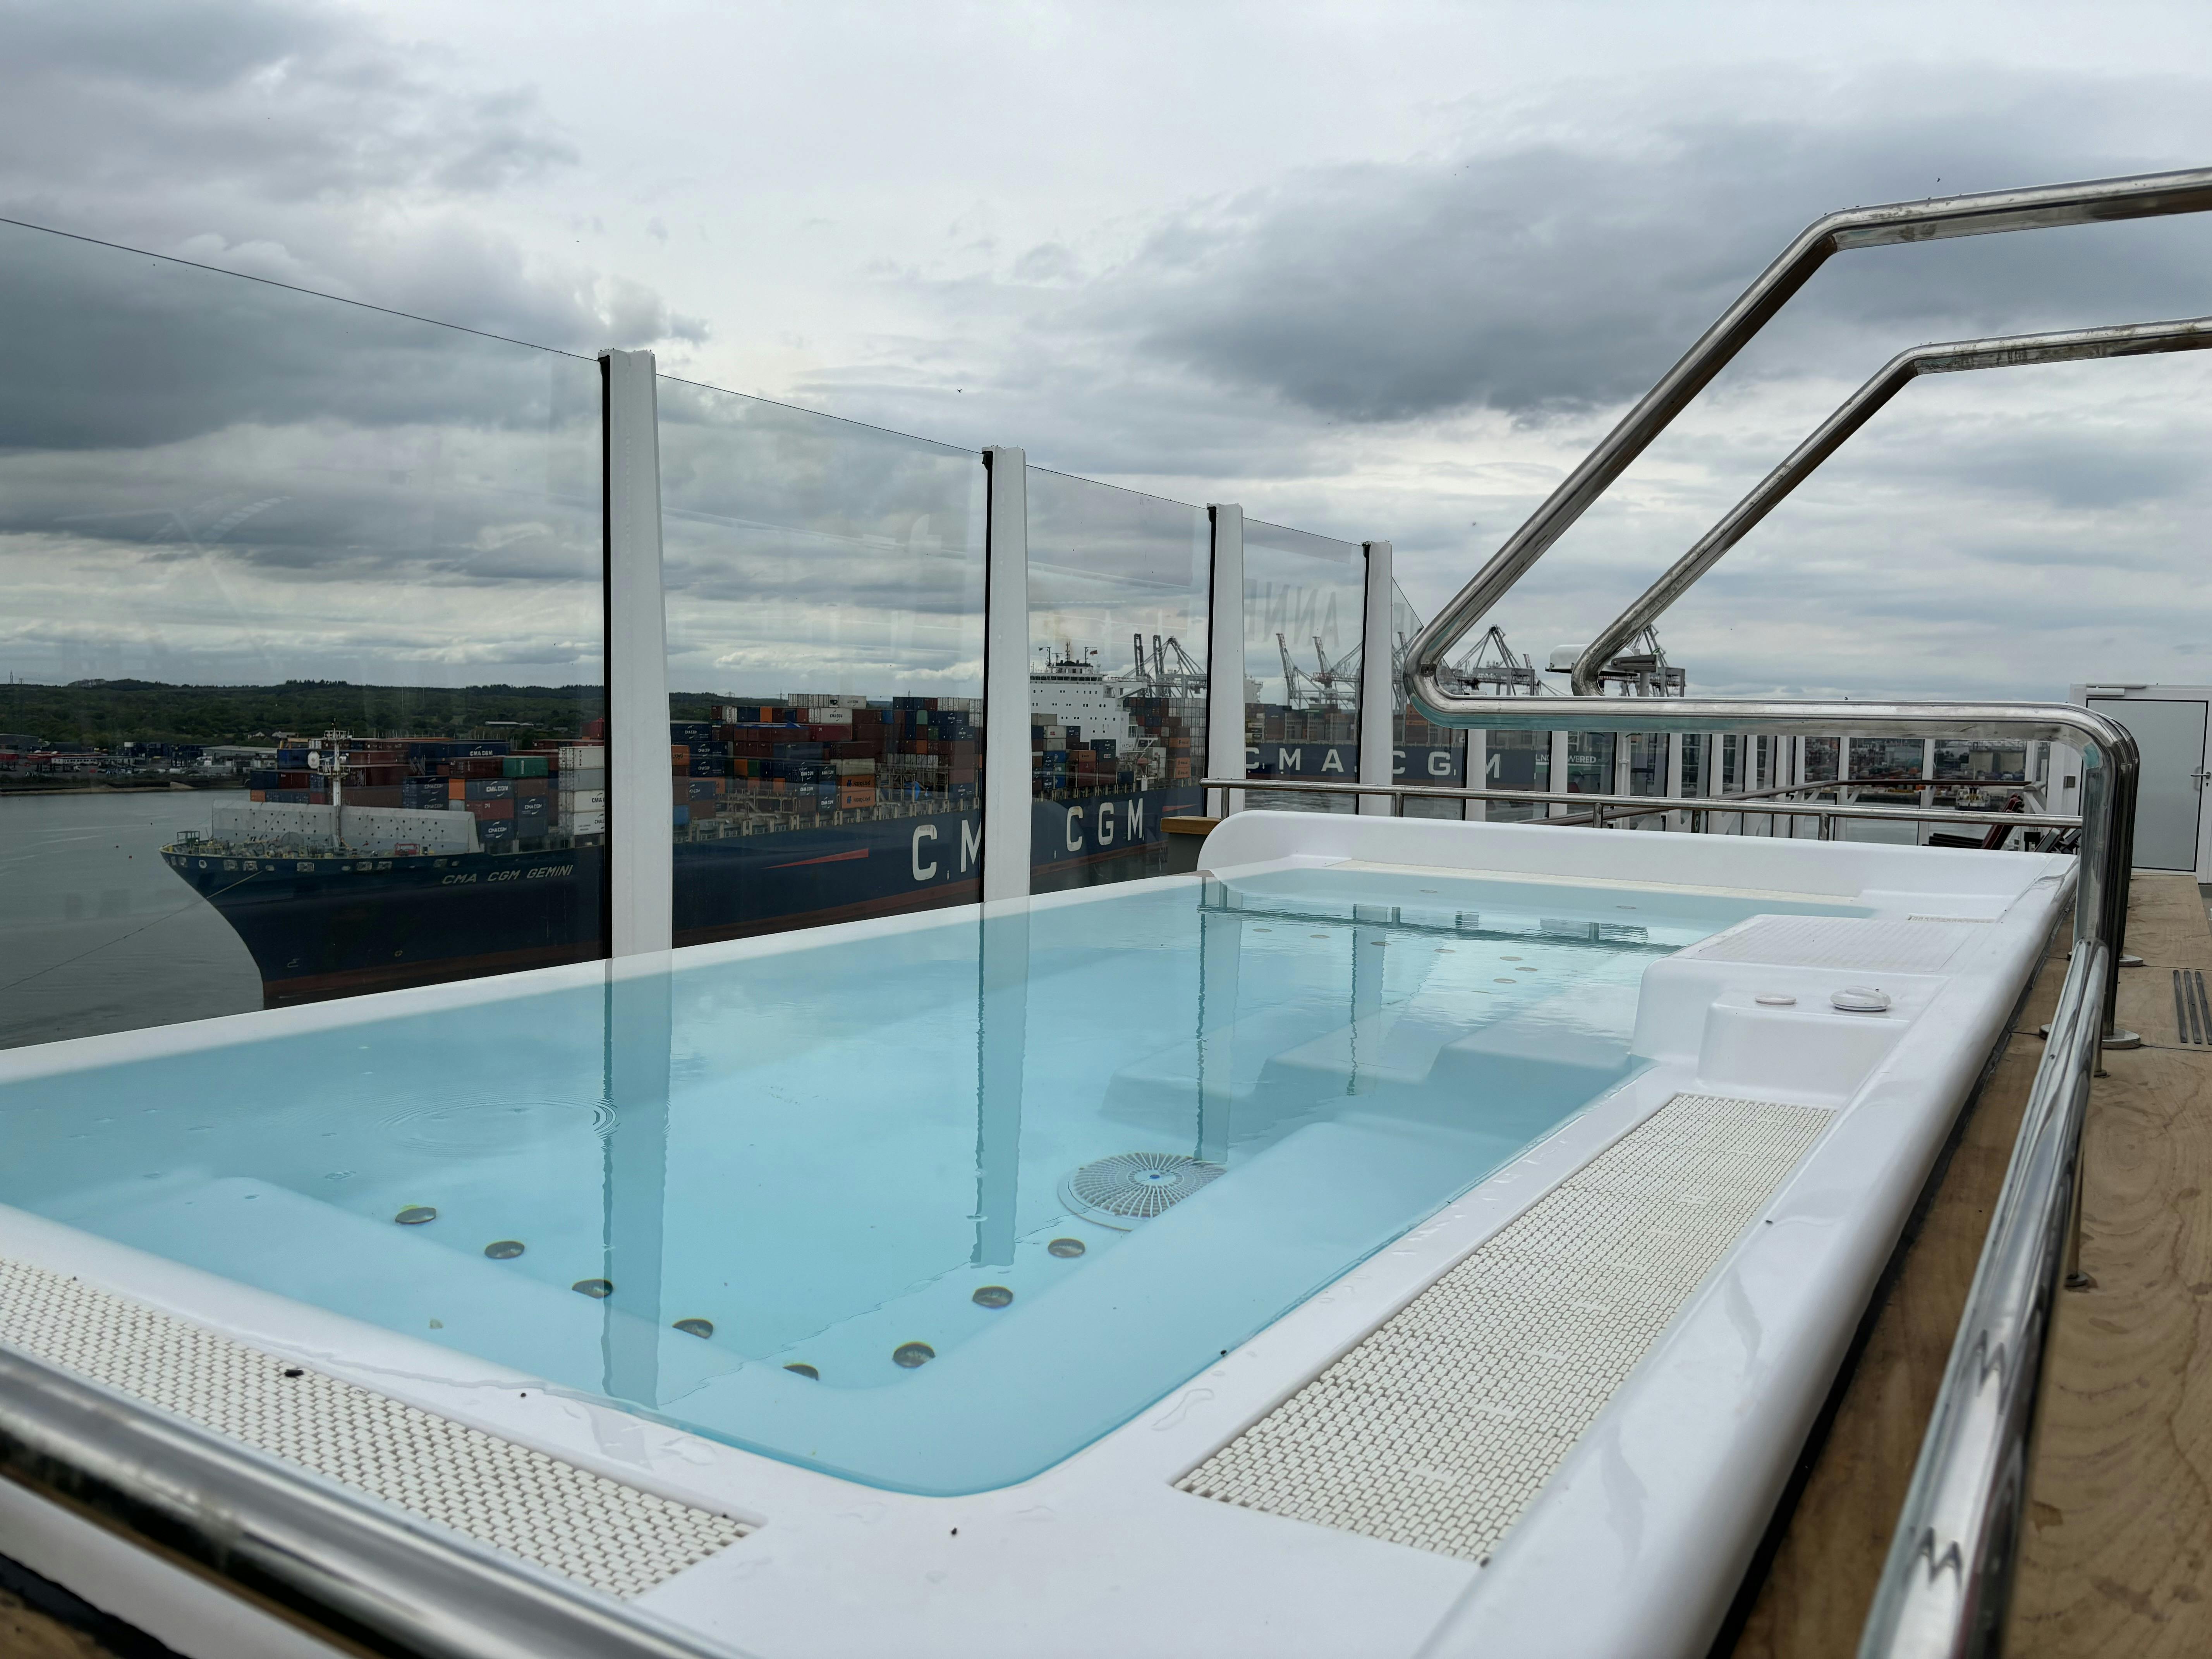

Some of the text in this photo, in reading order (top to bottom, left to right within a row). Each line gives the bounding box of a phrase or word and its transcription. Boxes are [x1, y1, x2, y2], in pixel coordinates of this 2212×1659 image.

[1246, 747, 1501, 778] CMA CGM
[1568, 755, 1597, 763] WERED
[912, 798, 1143, 881] CM CGM
[442, 864, 574, 884] CMA CGM GEMINI
